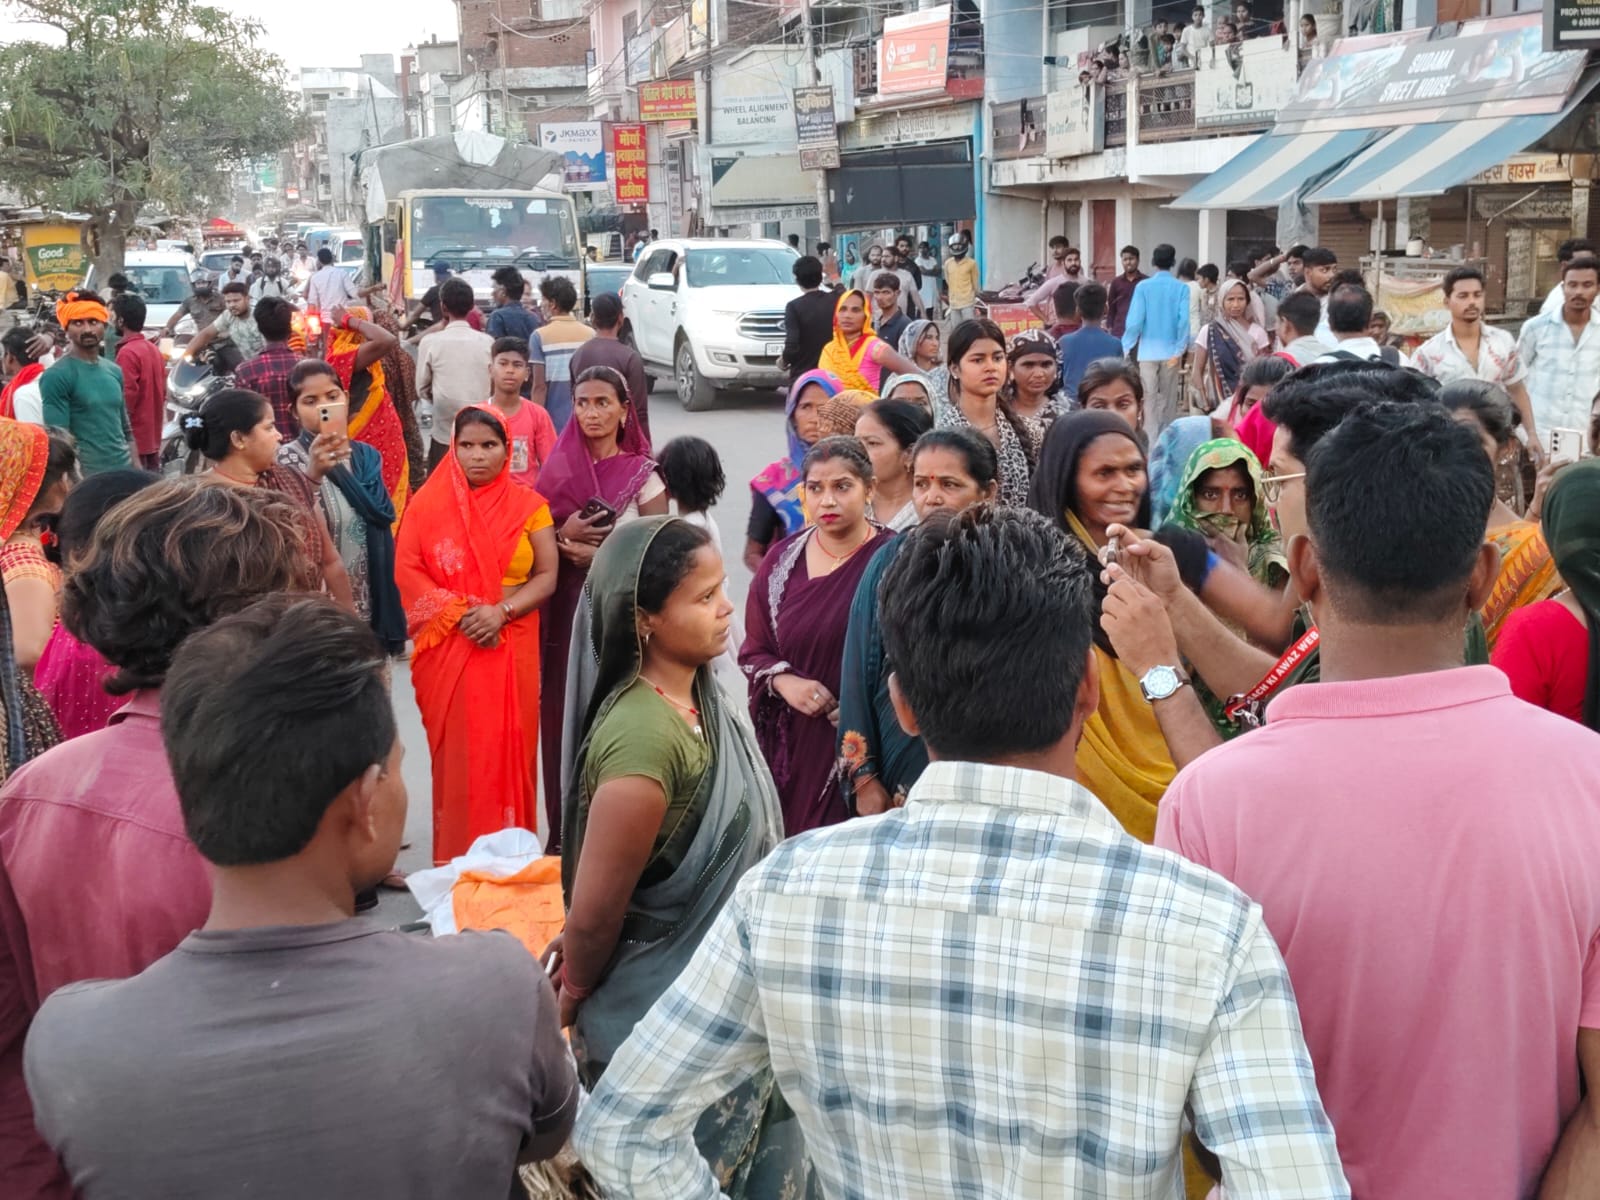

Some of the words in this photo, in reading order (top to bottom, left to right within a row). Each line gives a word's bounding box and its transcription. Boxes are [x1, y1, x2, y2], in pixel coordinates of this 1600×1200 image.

[1407, 48, 1456, 74] SUDAMA
[1378, 78, 1420, 103] SWEET
[1413, 74, 1456, 99] HOUSE
[722, 105, 747, 114] WHEEL
[748, 102, 789, 113] ALIGNMENT
[736, 115, 777, 126] BALANCING
[1507, 162, 1537, 183] हाउस
[38, 248, 64, 259] Good
[1265, 674, 1278, 686] KI
[1275, 650, 1301, 677] AWAZ
[1297, 630, 1320, 652] WEB
